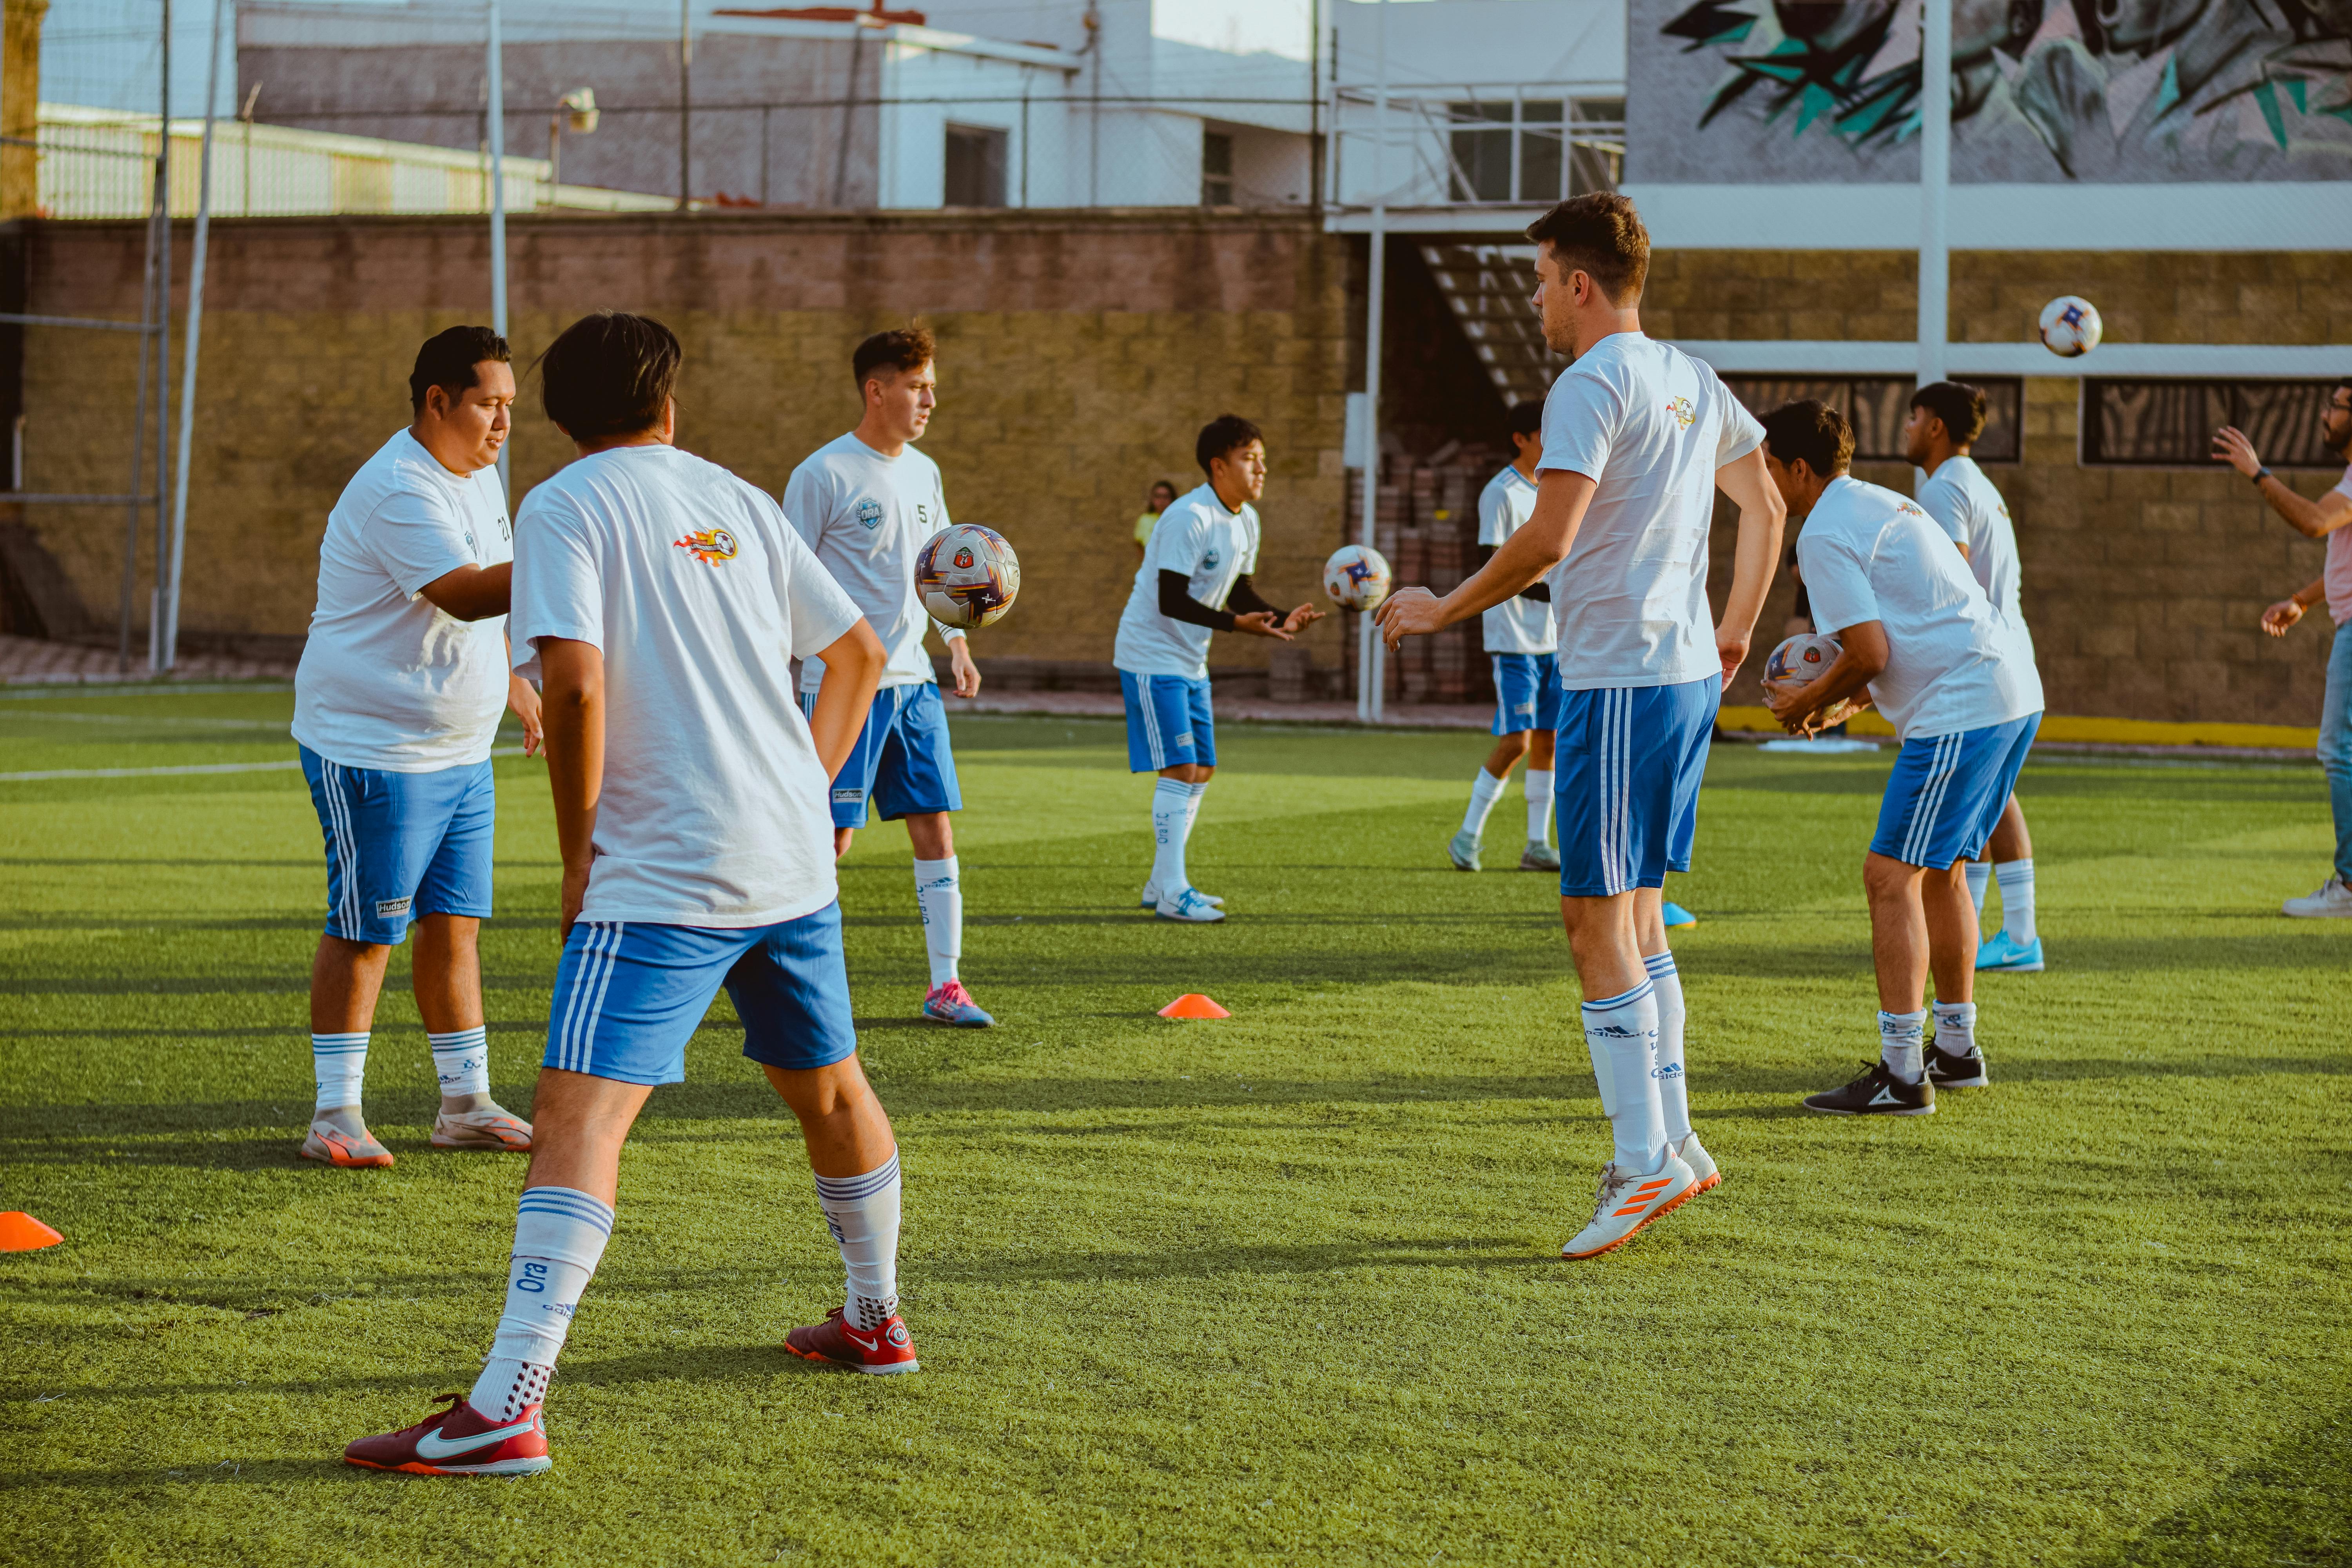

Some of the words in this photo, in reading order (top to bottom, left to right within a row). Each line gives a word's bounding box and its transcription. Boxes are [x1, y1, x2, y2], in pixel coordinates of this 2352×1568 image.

[861, 507, 881, 519] ORA
[917, 504, 928, 524] 5
[497, 516, 510, 543] 21
[1157, 829, 1168, 844] Ora
[379, 901, 410, 912] Hudson
[516, 1262, 548, 1292] Ora
